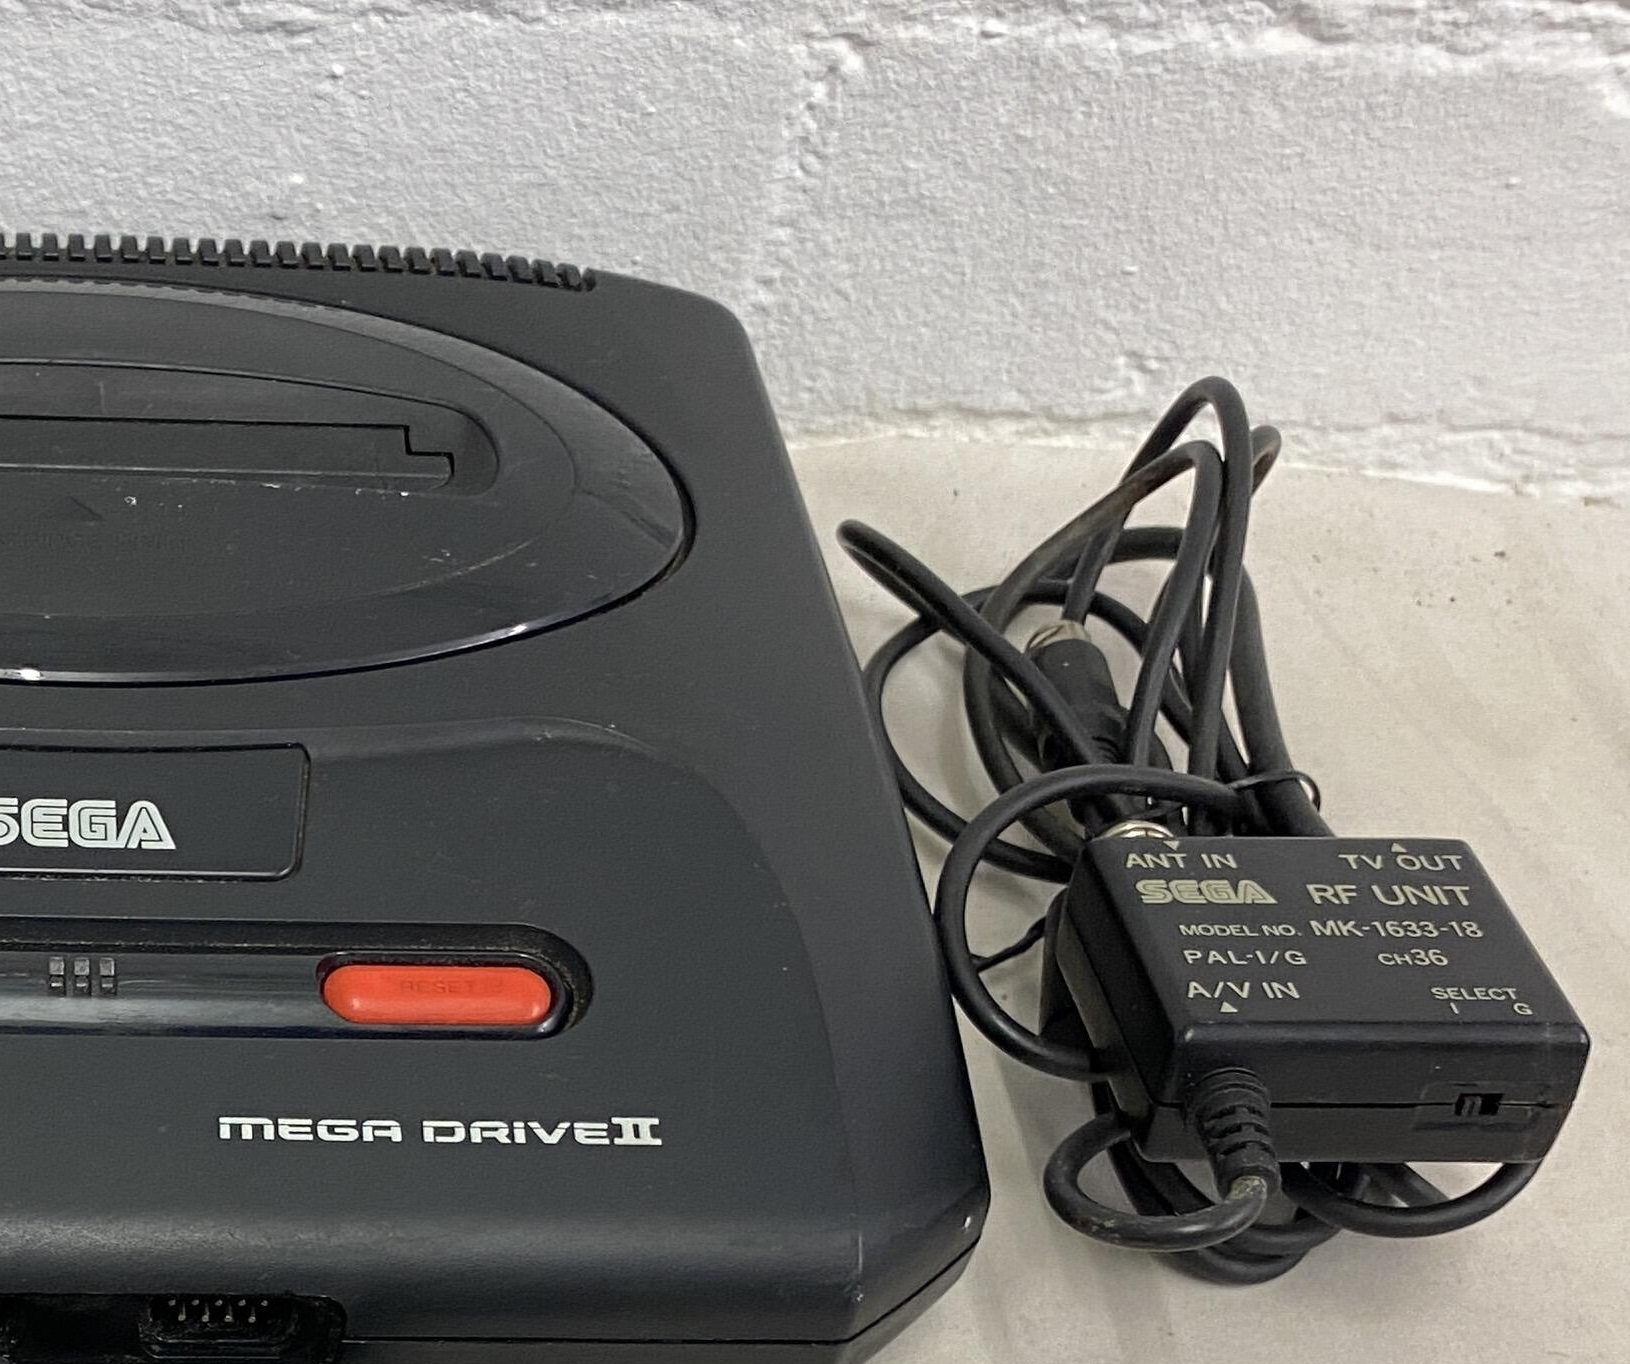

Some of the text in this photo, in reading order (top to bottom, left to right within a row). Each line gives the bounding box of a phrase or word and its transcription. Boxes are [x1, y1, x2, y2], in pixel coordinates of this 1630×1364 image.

[1125, 852, 1237, 869] ANT IN
[1339, 853, 1463, 871] TV OUT
[1135, 879, 1472, 906] SEGA RF UNIT
[1179, 919, 1483, 939] MODEL NO. MK-1633-18
[1183, 949, 1307, 967] PAL-I/G
[1187, 980, 1300, 999] A/V IN
[1431, 986, 1517, 1001] SELECT
[1513, 1003, 1533, 1016] G
[219, 1116, 403, 1142] MEGA
